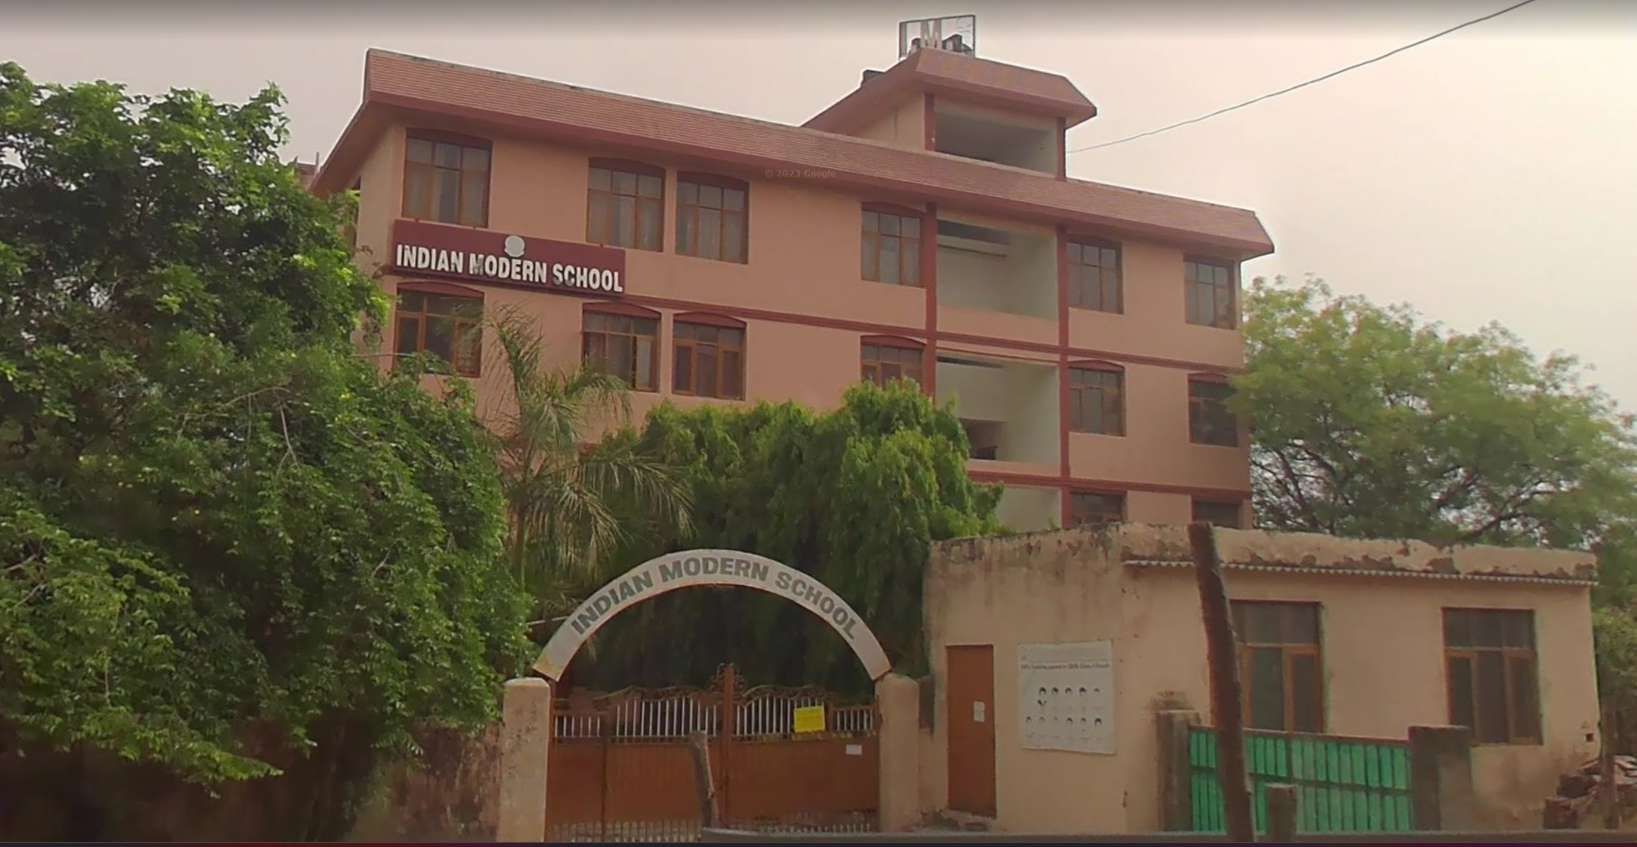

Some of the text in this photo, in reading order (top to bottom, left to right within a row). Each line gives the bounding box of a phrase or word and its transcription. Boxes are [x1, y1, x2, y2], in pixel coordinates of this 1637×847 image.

[396, 244, 624, 292] INDIAN MODERN SCHOOL
[570, 557, 856, 640] INDIAN MODERN SCHOOL
